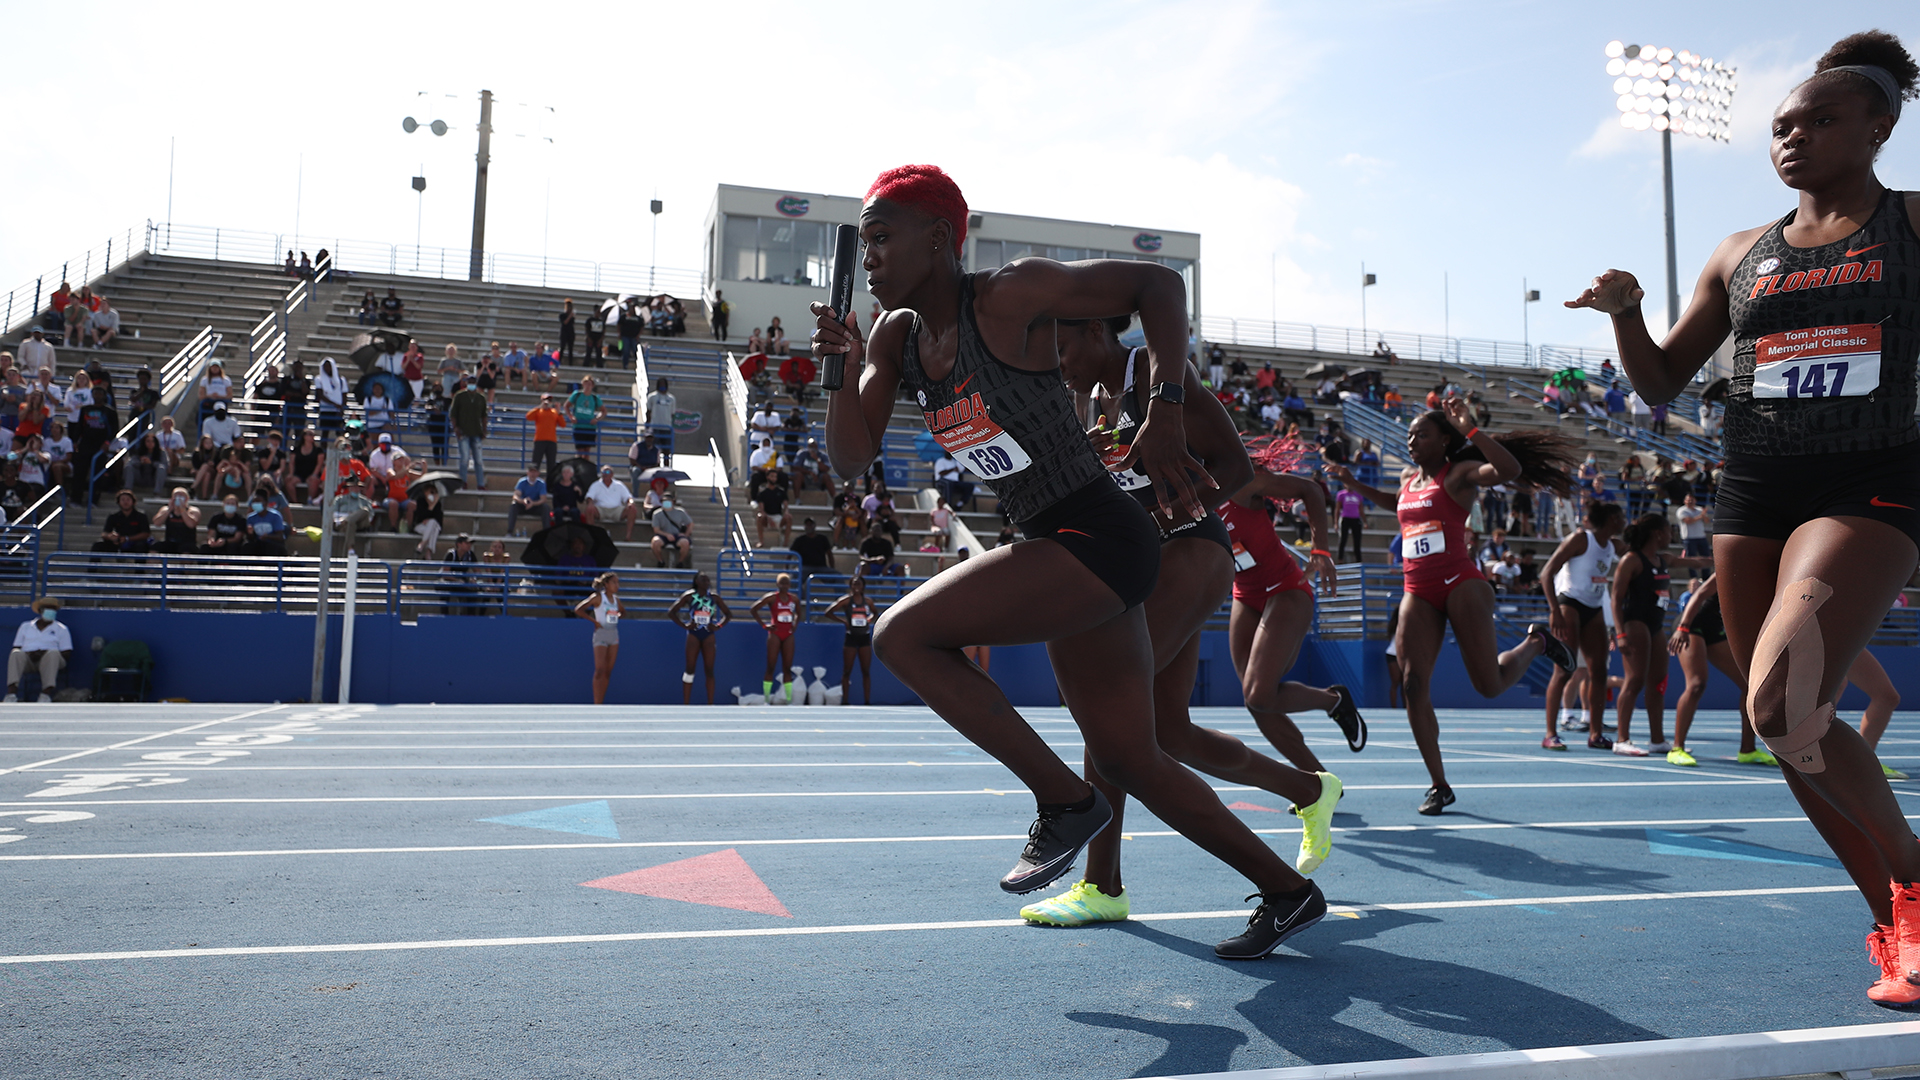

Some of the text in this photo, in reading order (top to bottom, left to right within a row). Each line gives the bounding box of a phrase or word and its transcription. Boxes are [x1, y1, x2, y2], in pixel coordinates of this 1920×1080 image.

[1757, 259, 1780, 274] SEC
[1747, 260, 1883, 300] FLORIDA
[1784, 326, 1848, 341] Tom Jones
[1768, 337, 1867, 355] Memorial Classic
[1782, 362, 1849, 398] 147
[924, 391, 986, 433] FLORIDA
[942, 424, 974, 440] Tom Jones
[943, 427, 991, 449] Memorial Classic
[968, 445, 1014, 477] 130
[1413, 537, 1430, 555] 15
[1800, 593, 1814, 602] KT
[122, 750, 252, 766] 5
[24, 773, 190, 798] 4
